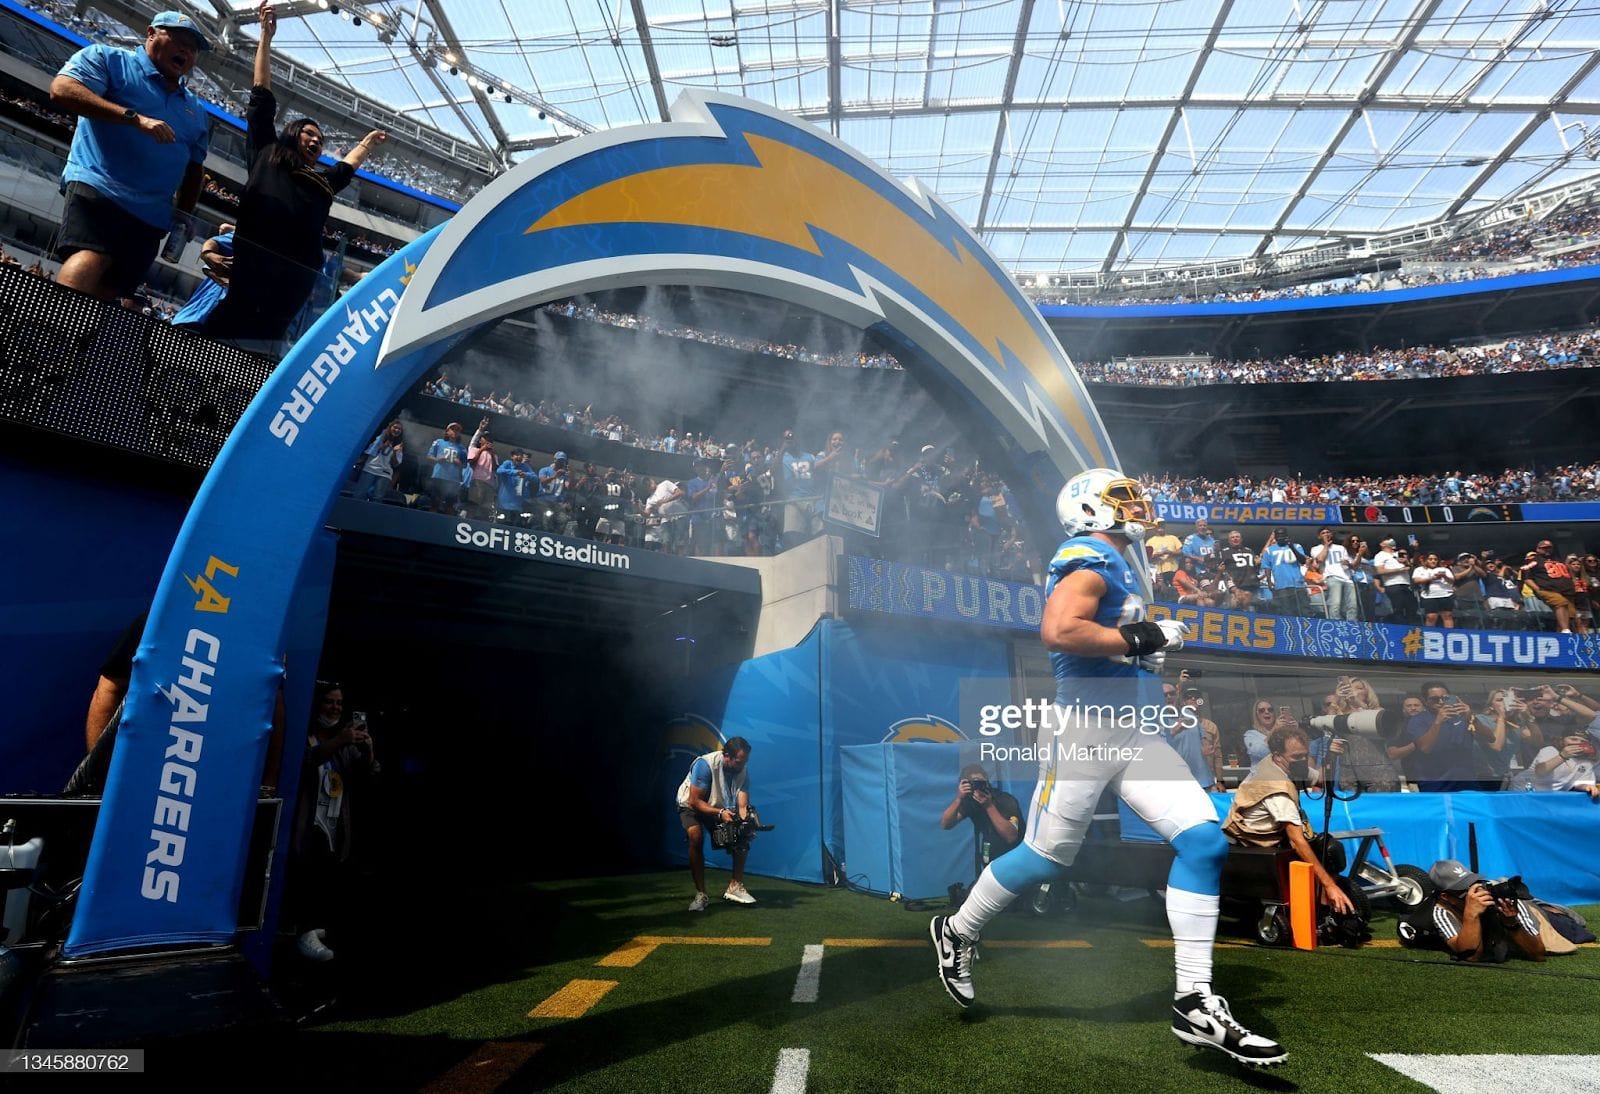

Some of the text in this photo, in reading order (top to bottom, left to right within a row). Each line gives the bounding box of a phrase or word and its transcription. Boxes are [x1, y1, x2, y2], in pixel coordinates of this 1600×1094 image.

[268, 287, 400, 448] CHARGERS
[1071, 478, 1091, 498] 97
[1158, 503, 1326, 523] PURO CHARGERS
[1403, 507, 1413, 523] 0
[1443, 506, 1454, 523] 0
[455, 521, 631, 570] SoFi Stadium
[1232, 552, 1254, 568] 57
[1273, 549, 1297, 566] 70
[920, 568, 1042, 626] PURO
[1402, 626, 1560, 665] #BOLTUP
[140, 555, 240, 903] LA CHARGERS
